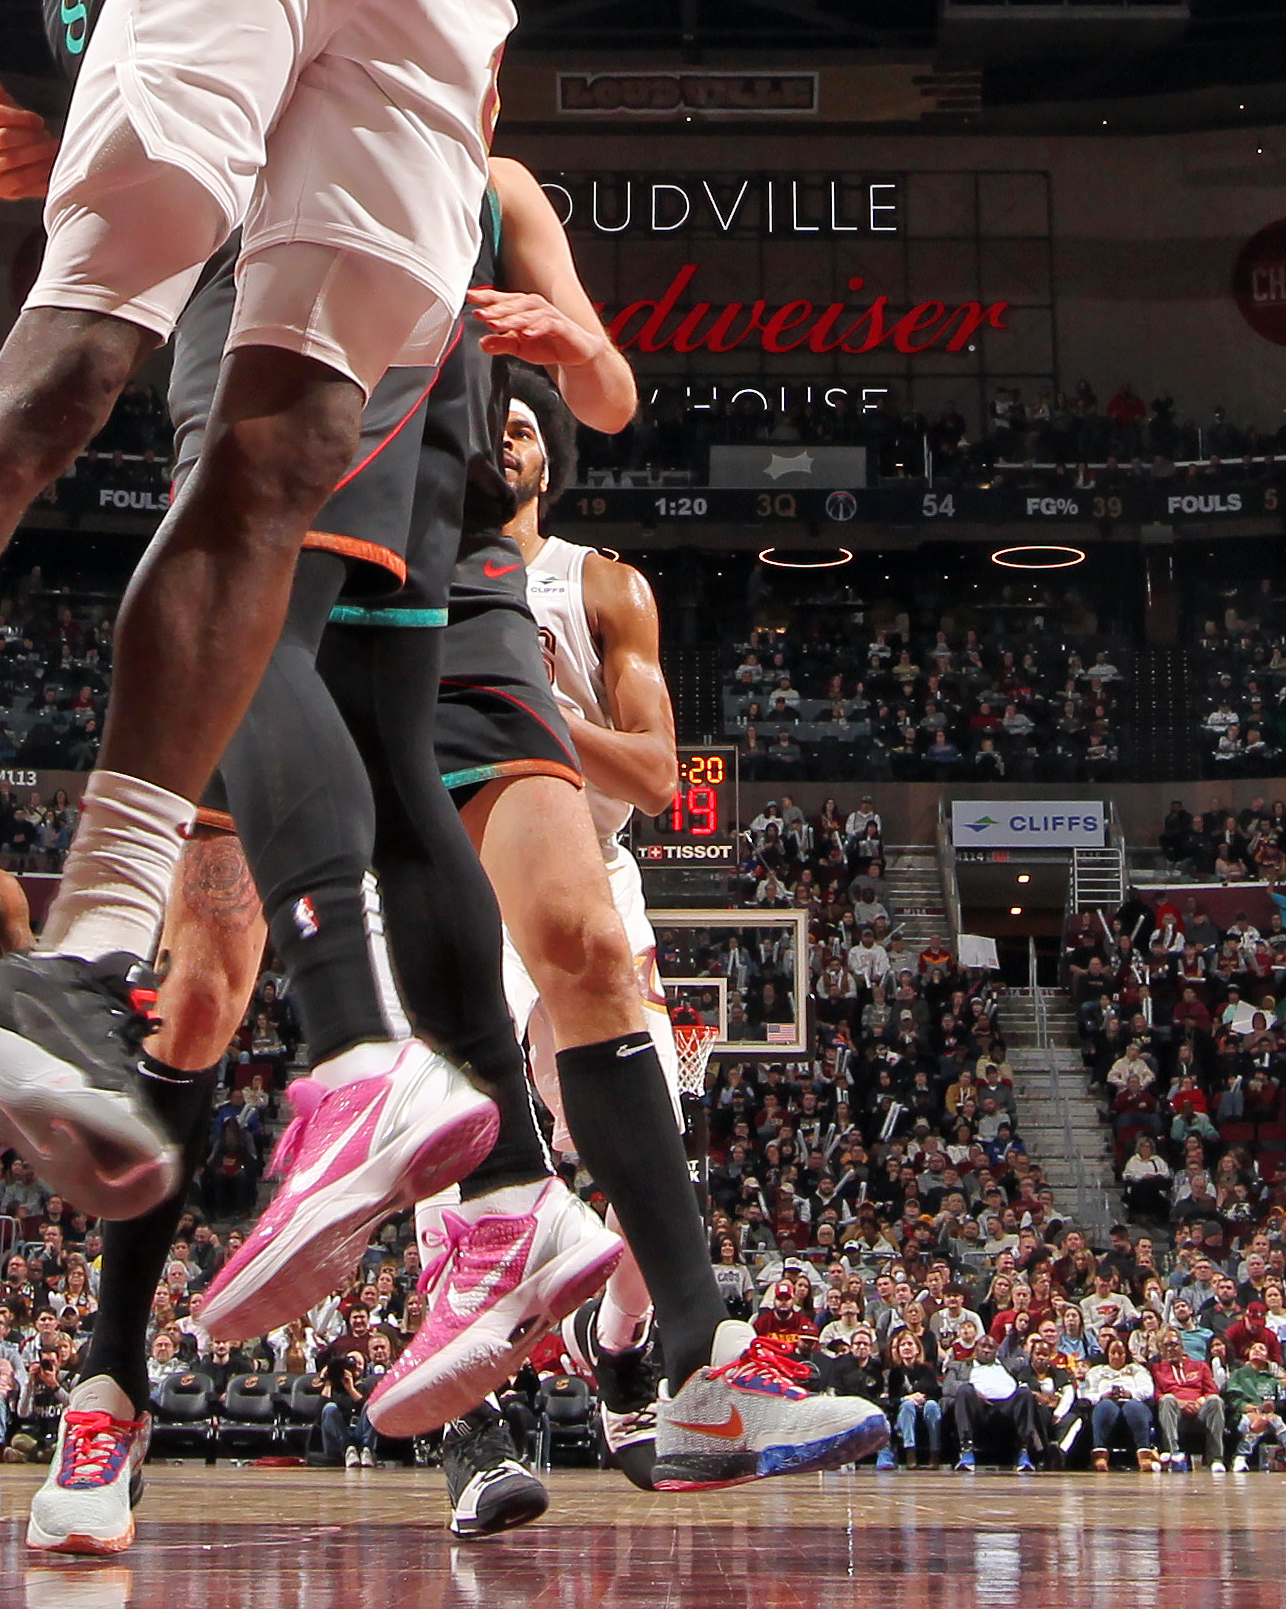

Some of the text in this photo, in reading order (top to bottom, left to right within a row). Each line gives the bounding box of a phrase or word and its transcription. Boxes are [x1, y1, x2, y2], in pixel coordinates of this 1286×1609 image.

[594, 263, 1009, 354] dweiser
[99, 490, 171, 511] FOULS
[655, 497, 708, 516] 1:20
[757, 493, 796, 518] 3Q
[922, 493, 955, 517] 54
[1026, 497, 1078, 516] FG%
[1093, 496, 1122, 518] 39
[1167, 493, 1242, 513] FOULS
[681, 756, 724, 784] :20
[672, 786, 717, 835] 19
[1009, 816, 1098, 832] CLIFFS
[663, 846, 733, 859] TISSOT
